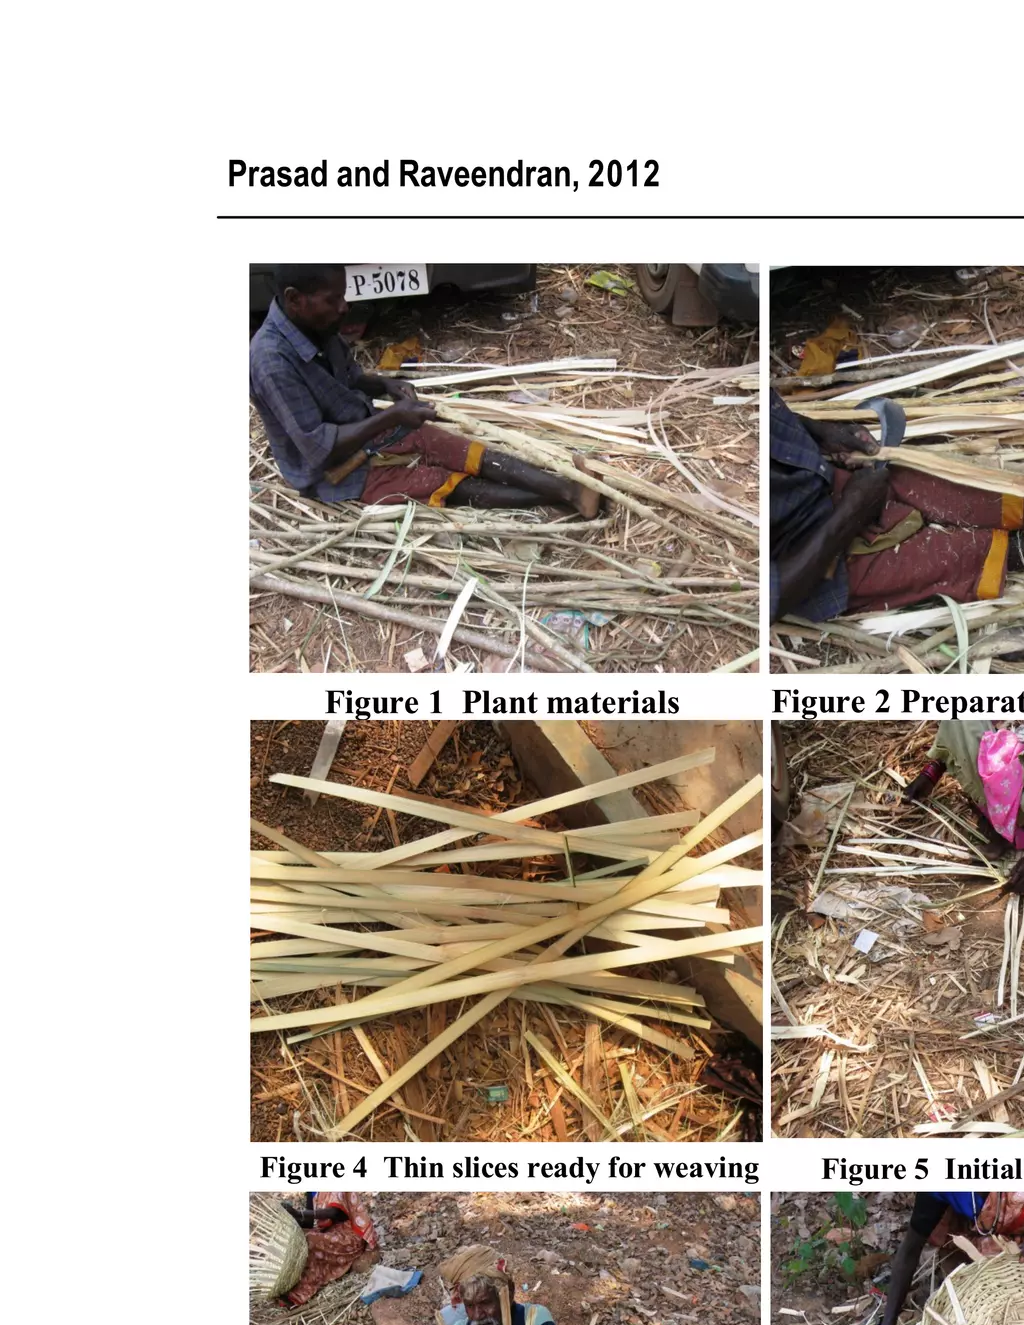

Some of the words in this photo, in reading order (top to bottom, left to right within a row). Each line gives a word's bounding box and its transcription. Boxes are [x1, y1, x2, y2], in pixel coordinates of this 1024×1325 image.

[228, 159, 328, 188] Prasad
[336, 159, 390, 188] and
[399, 159, 579, 193] Raveendran,
[588, 159, 660, 188] 2012
[325, 689, 419, 720] Figure
[430, 689, 443, 714] 1
[462, 690, 539, 714] Plant
[546, 689, 680, 715] materials
[771, 688, 866, 720] Figure
[875, 688, 891, 713] 2
[260, 1155, 345, 1185] Figure
[352, 1155, 368, 1178] 4
[383, 1155, 444, 1178] Thin
[452, 1155, 519, 1179] slices
[527, 1156, 601, 1185] ready
[608, 1155, 647, 1179] for
[653, 1155, 760, 1185] weaving
[821, 1157, 907, 1187] Figure
[914, 1158, 929, 1180] 5
[945, 1157, 1023, 1180] Initial
